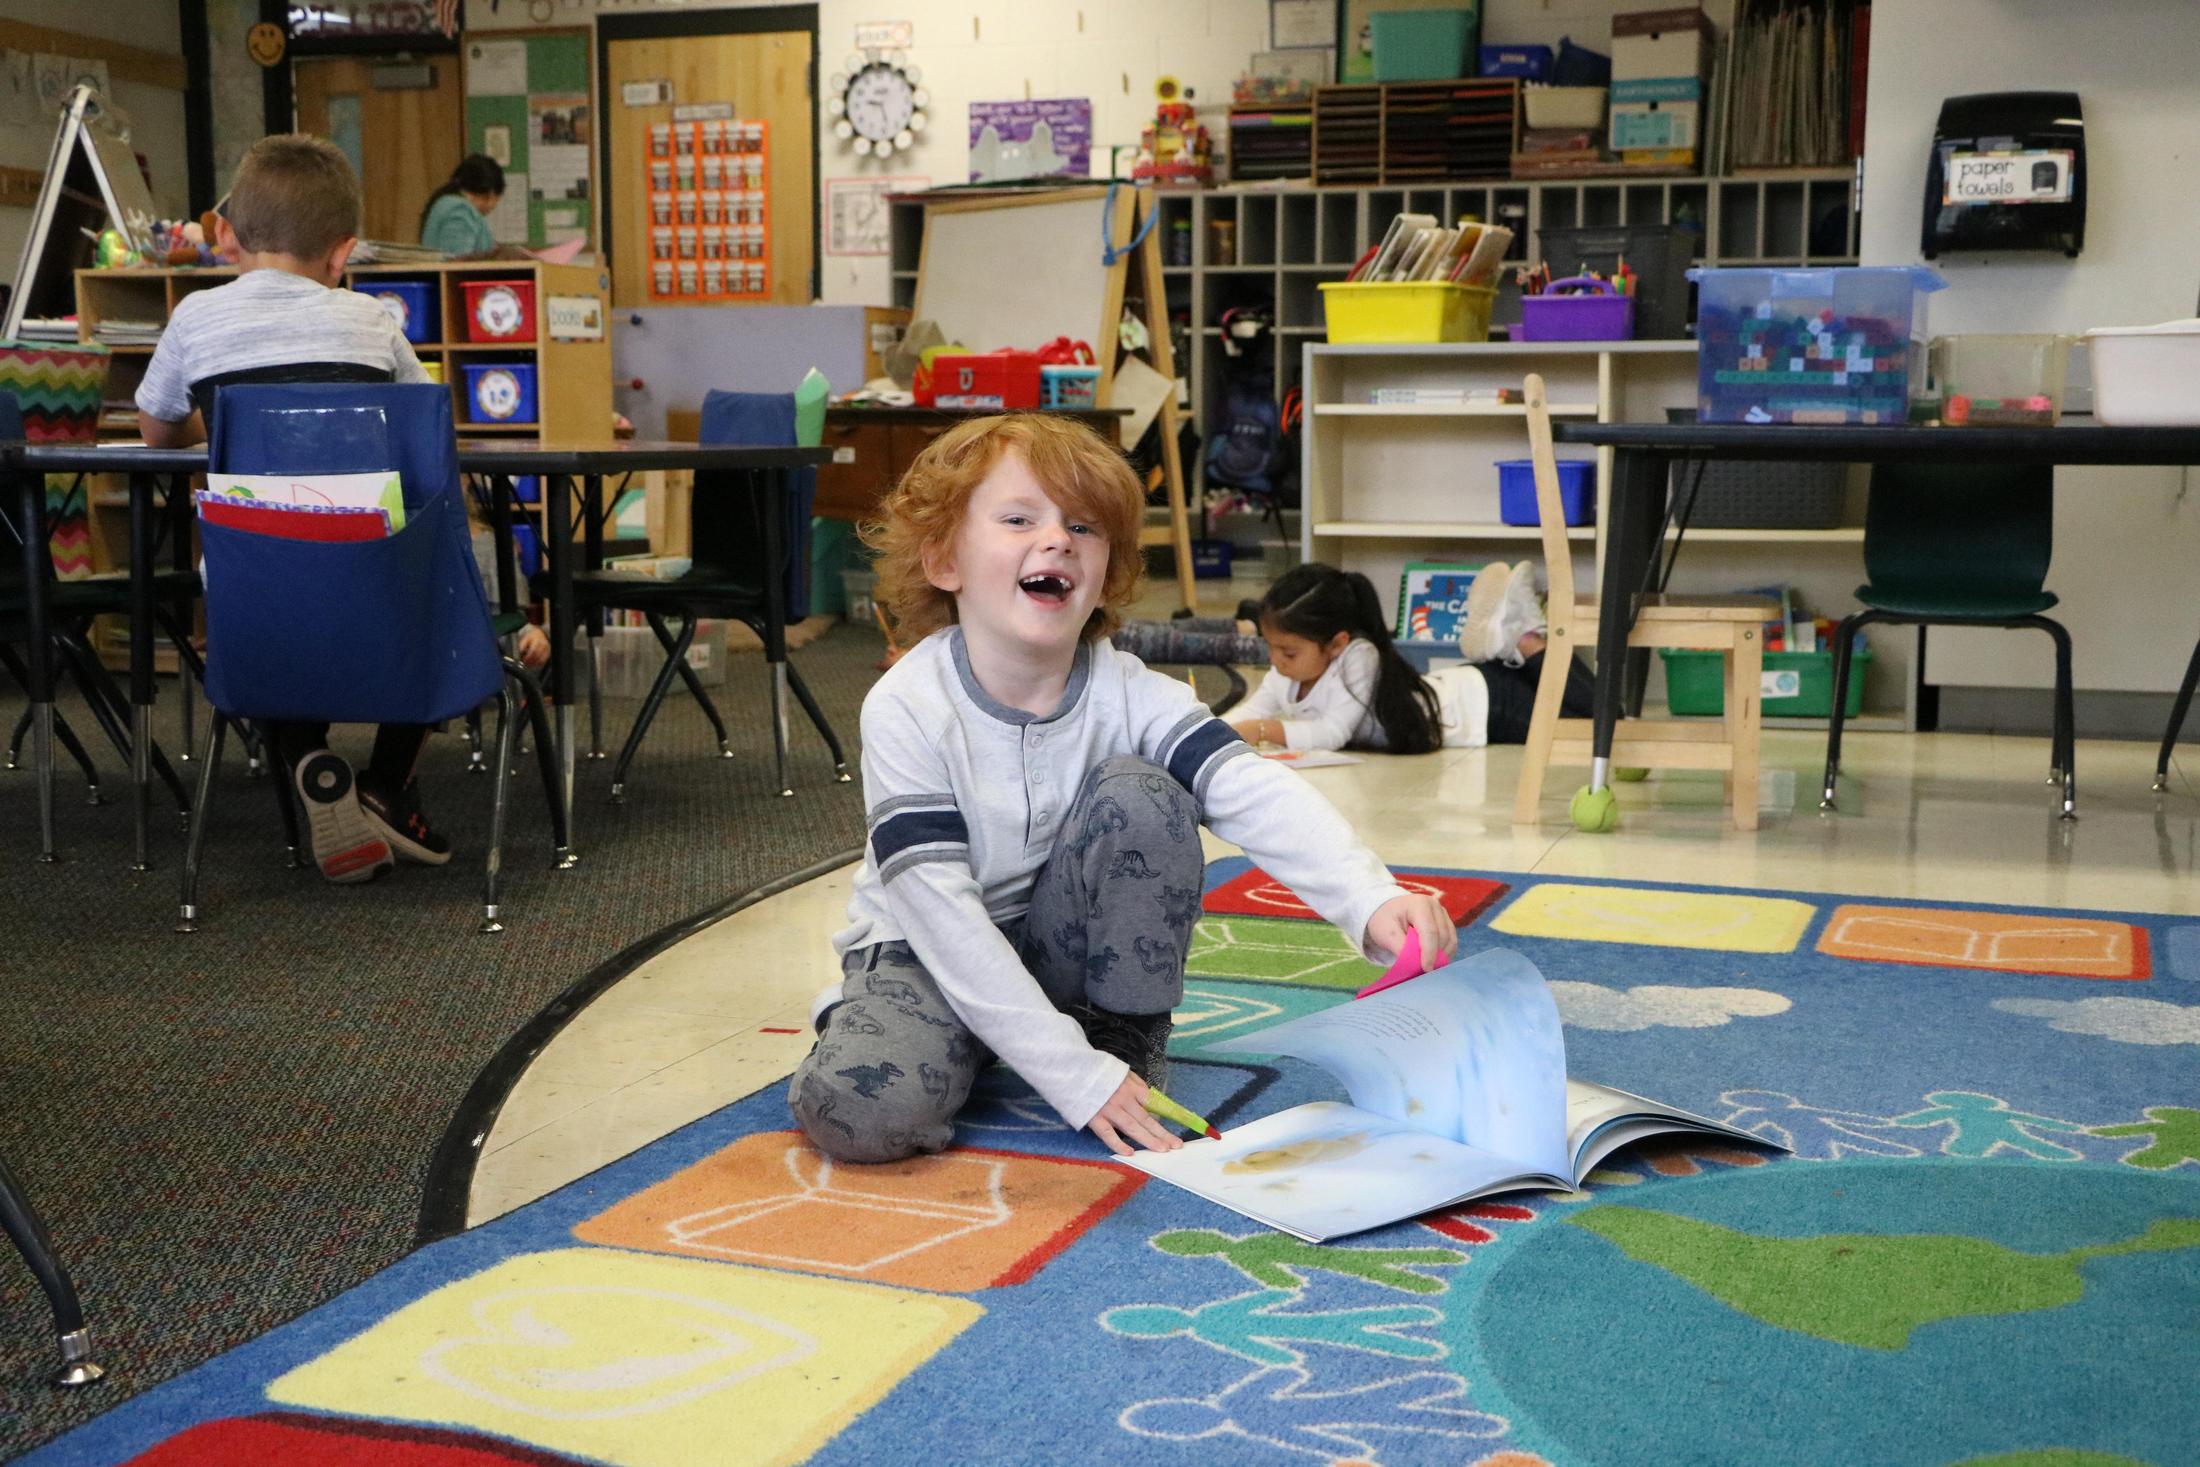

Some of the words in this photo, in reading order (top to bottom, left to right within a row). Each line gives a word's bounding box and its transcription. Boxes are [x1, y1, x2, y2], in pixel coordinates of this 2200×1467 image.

[1961, 161, 2015, 180] paper
[1958, 177, 2015, 196] towels
[1425, 600, 1446, 611] THE
[1447, 599, 1470, 614] CA
